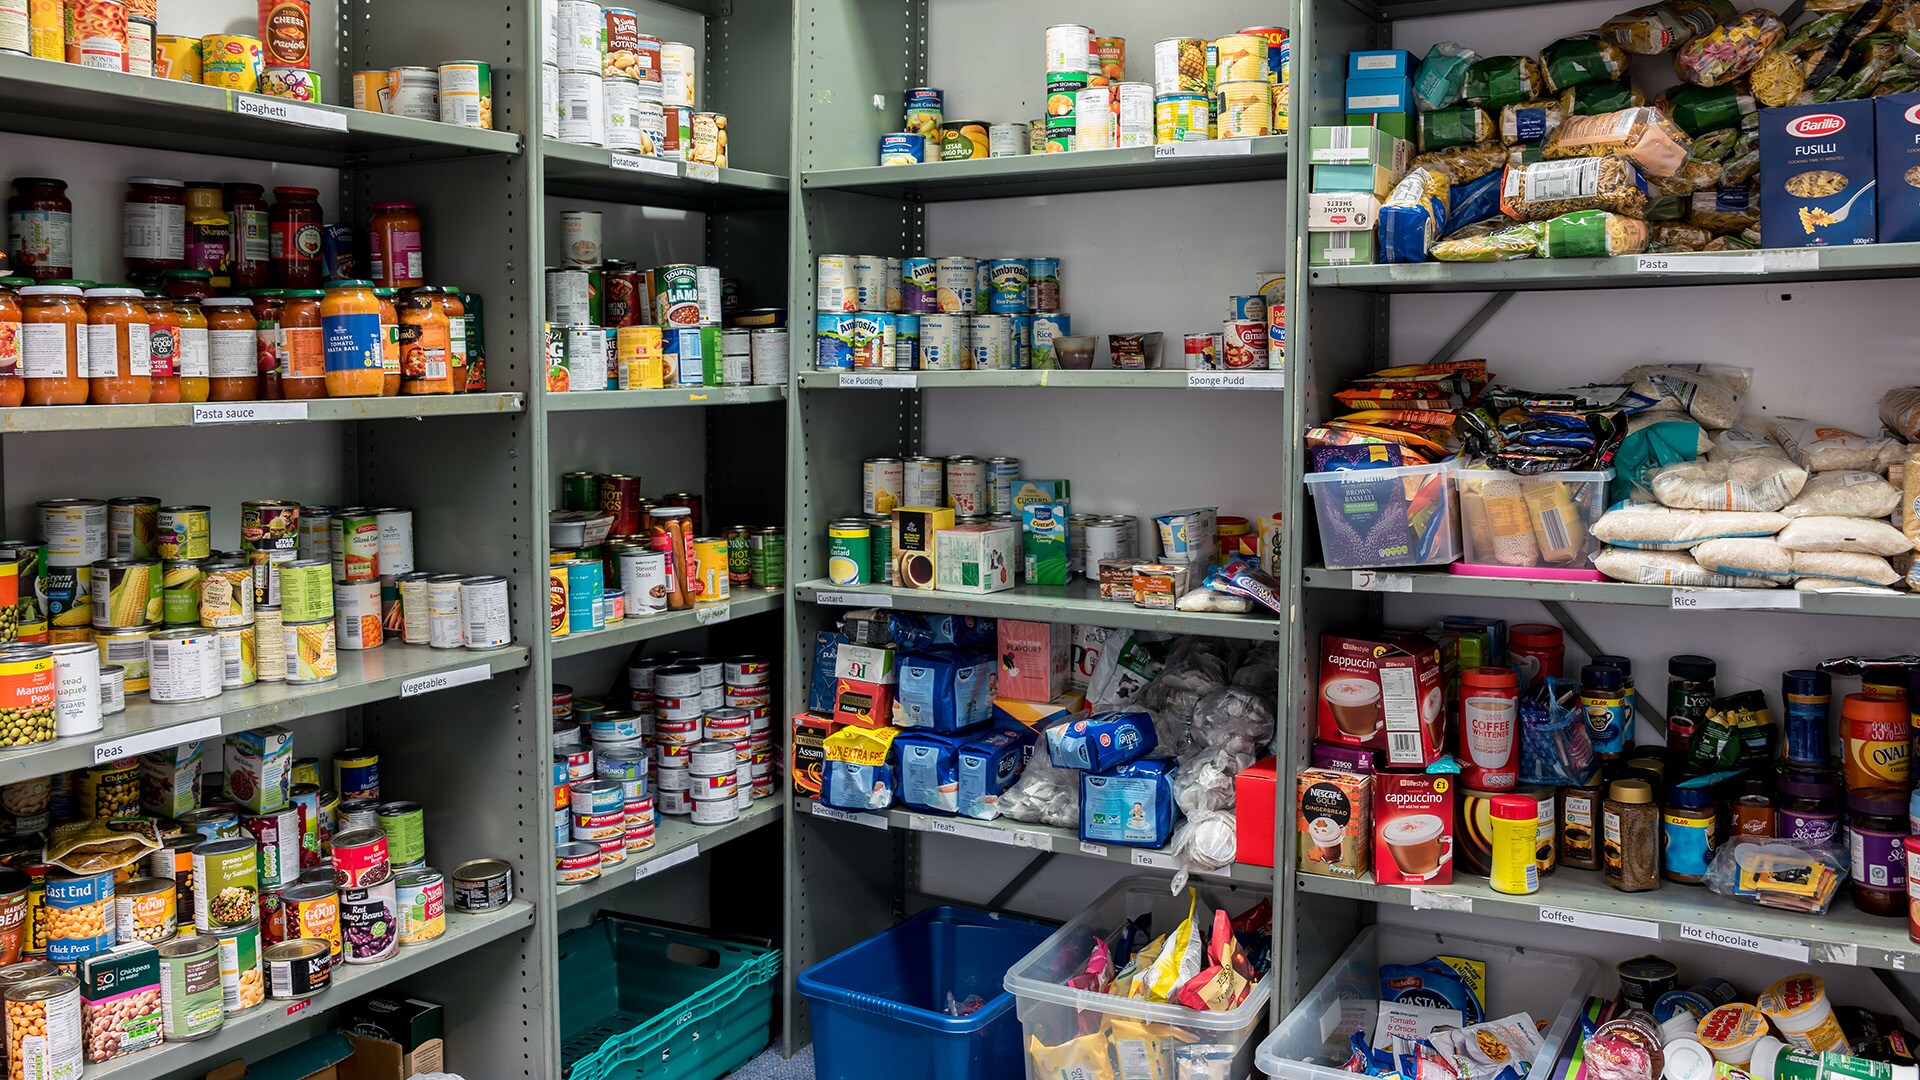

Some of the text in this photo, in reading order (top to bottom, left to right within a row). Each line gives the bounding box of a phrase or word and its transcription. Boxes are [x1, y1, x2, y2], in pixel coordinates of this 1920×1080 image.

[274, 16, 304, 27] CHEESE
[273, 39, 306, 50] ravioli
[240, 100, 287, 117] Spaghetti
[1799, 118, 1840, 131] Barilla
[957, 148, 973, 156] PULP
[1156, 147, 1175, 155] Fruit
[1795, 144, 1836, 156] FUSILLI
[613, 157, 639, 168] Potatoes
[1639, 260, 1668, 269] Pasta
[991, 266, 1028, 280] Ambrosia
[668, 289, 698, 302] LAMB
[841, 376, 883, 386] Rice Pudding
[1189, 376, 1245, 386] Sponge Pudd
[196, 408, 254, 419] Pasta sauce
[1345, 488, 1372, 496] BROWN
[1344, 494, 1375, 502] BASMATI
[1032, 520, 1055, 528] Custard
[732, 550, 748, 559] HOT
[830, 549, 850, 557] Custard
[729, 558, 751, 566] DOGS
[818, 594, 843, 603] Custard
[1675, 596, 1697, 606] Rice
[1007, 645, 1041, 653] FLAVOUR?
[1072, 644, 1099, 676] PG
[62, 676, 82, 685] peas
[403, 677, 447, 693] Vegetables
[58, 686, 87, 695] garden
[31, 694, 50, 703] Peas
[61, 701, 85, 709] savers
[841, 704, 857, 712] Assam
[1472, 719, 1510, 731] COFFEE
[1472, 729, 1510, 739] WHITENER
[1871, 721, 1894, 741] 33%
[96, 745, 123, 759] Peas
[798, 748, 823, 758] Assam
[844, 747, 867, 760] EXTRA
[998, 755, 1016, 773] Tetley
[1407, 779, 1429, 788] lifestyle
[1436, 781, 1446, 789] £1
[559, 788, 564, 798] 4
[1385, 792, 1442, 803] cappuccino
[1315, 797, 1337, 806] GOLD
[1568, 802, 1588, 811] GOLD
[813, 805, 858, 821] Speciality Tea
[1305, 805, 1348, 816] GINGERBREAD
[933, 822, 955, 832] Treats
[1138, 854, 1153, 865] Tea
[636, 867, 648, 877] Fish
[68, 883, 92, 897] End
[137, 899, 165, 912] GOOD
[352, 906, 366, 914] Red
[305, 904, 335, 920] GOOD
[362, 910, 384, 920] Beans
[1541, 909, 1574, 923] Coffee
[1682, 925, 1759, 950] Hot chocolate
[50, 944, 90, 954] Chick Peas
[119, 963, 150, 976] Chickpeas
[97, 973, 114, 987] SO
[677, 1011, 692, 1025] IFCO
[1390, 1016, 1416, 1025] Tomato
[1394, 1025, 1416, 1033] Onion
